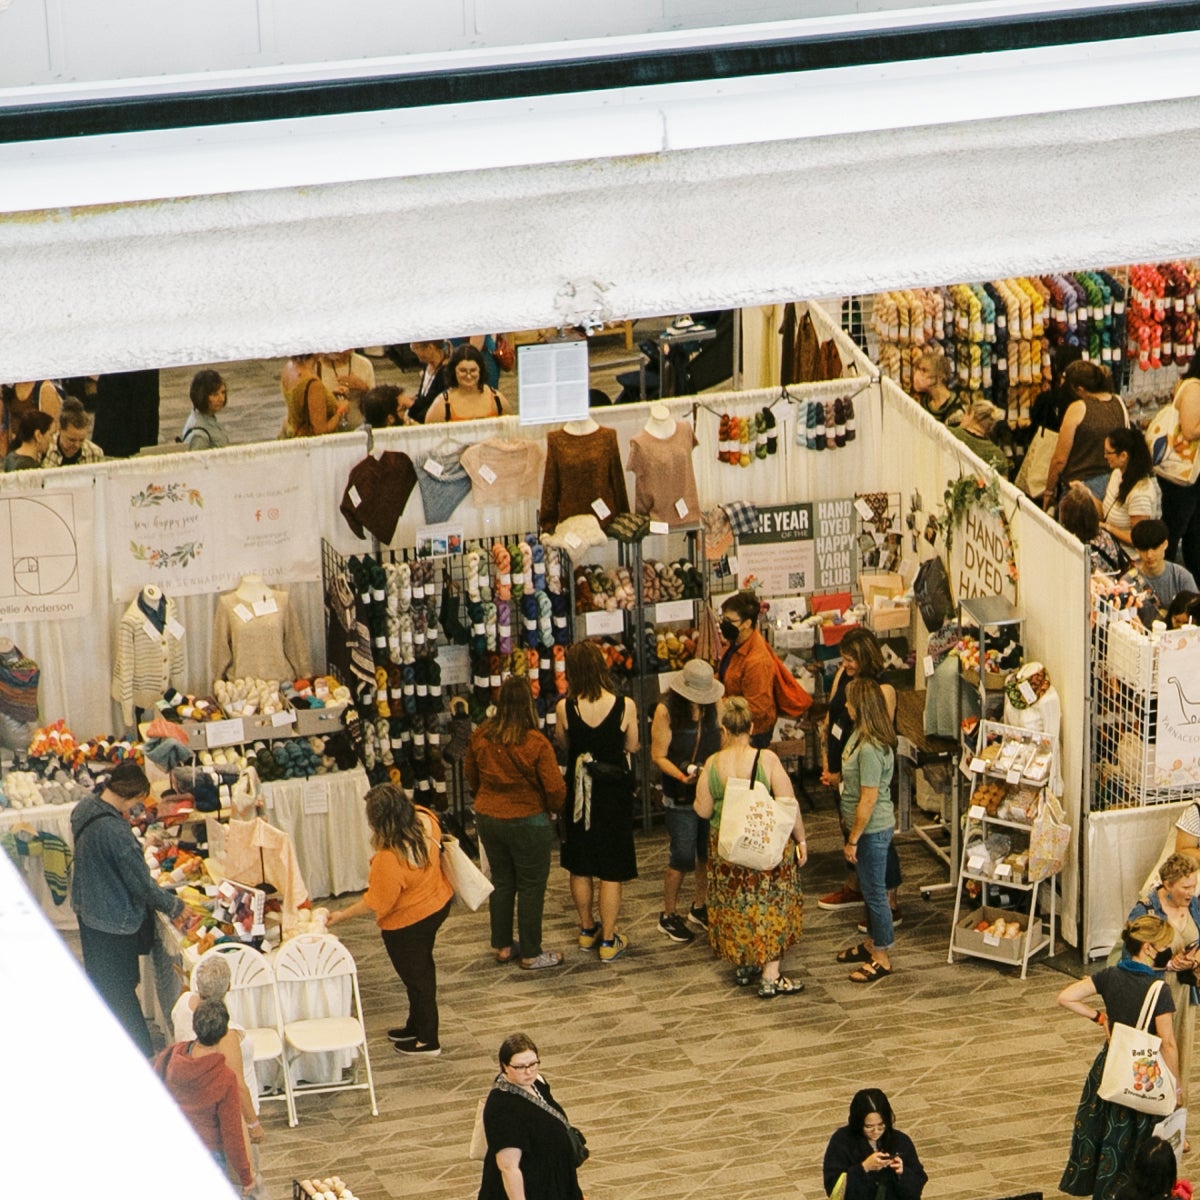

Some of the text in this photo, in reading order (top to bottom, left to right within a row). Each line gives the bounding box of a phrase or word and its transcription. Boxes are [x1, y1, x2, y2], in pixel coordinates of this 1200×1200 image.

[818, 500, 852, 519] HAND
[774, 510, 809, 532] YEAR
[820, 517, 851, 537] DYED
[781, 529, 808, 539] OF THE
[966, 508, 1003, 563] HAND
[816, 534, 855, 555] HAPPY
[818, 551, 850, 570] YARN
[965, 541, 1002, 595] DYED
[821, 568, 851, 588] CLUB
[23, 602, 74, 614] Anderson
